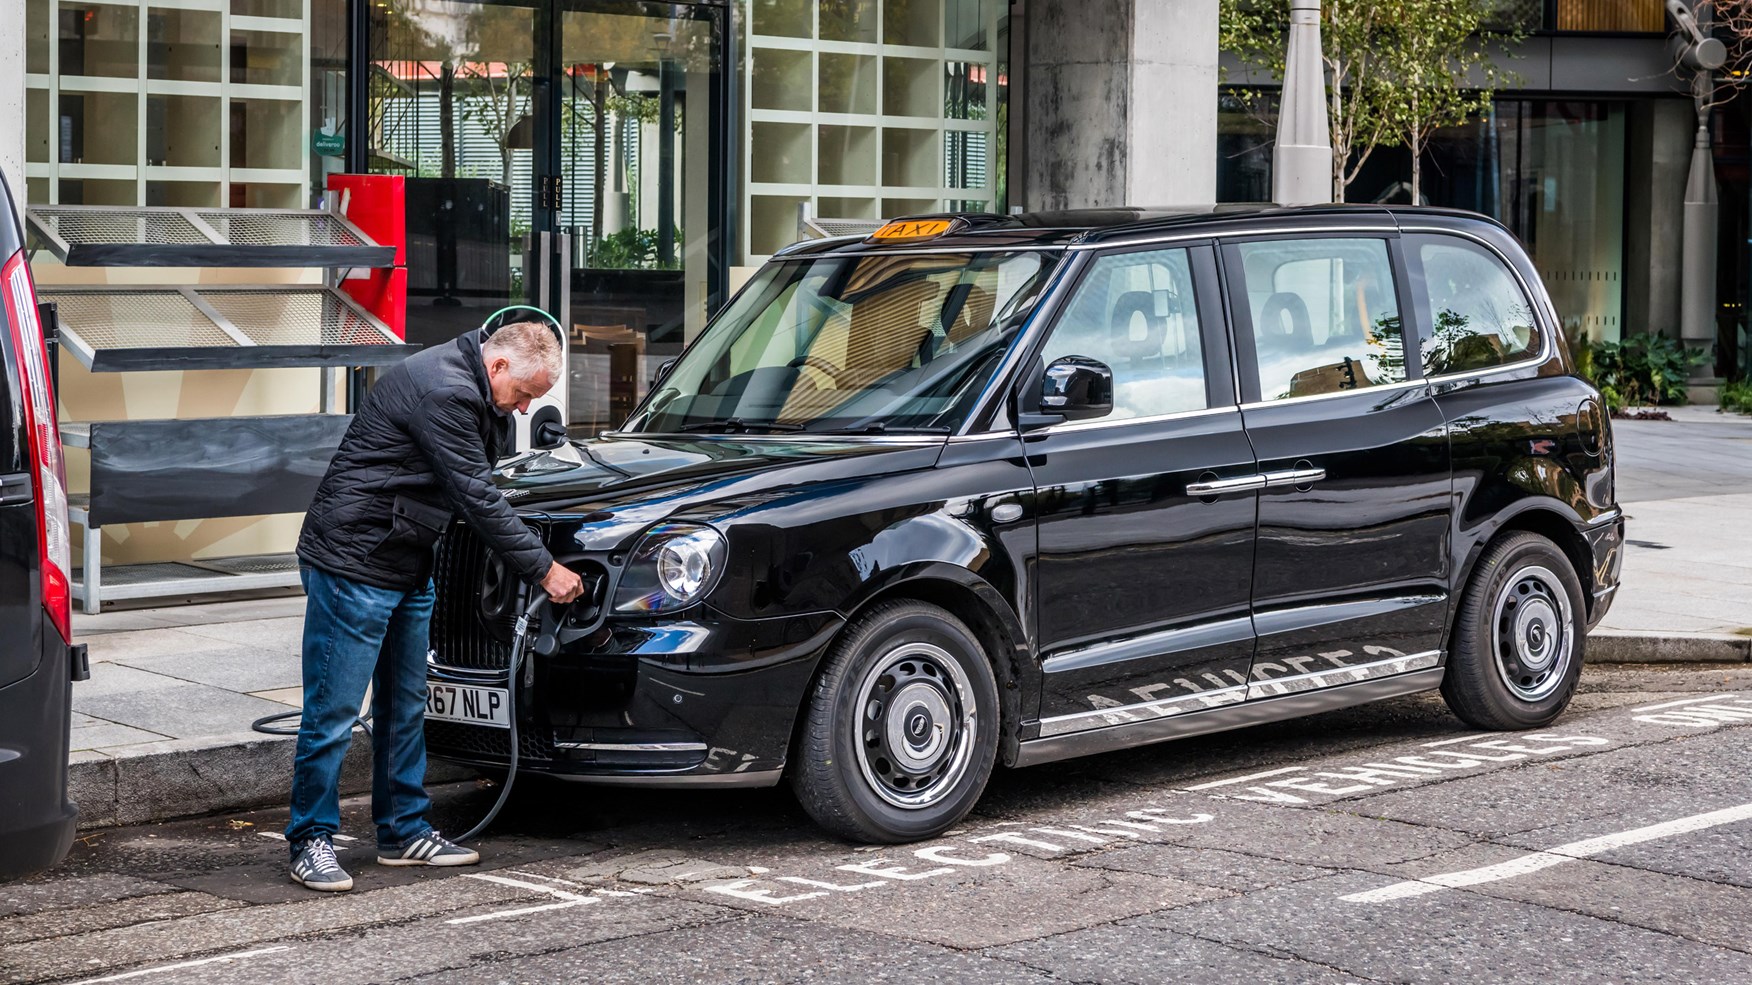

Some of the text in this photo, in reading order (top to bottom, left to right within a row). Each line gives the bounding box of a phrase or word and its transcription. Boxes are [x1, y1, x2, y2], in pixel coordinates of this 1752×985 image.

[880, 223, 939, 237] TAXI
[462, 689, 500, 720] NLP
[1209, 733, 1609, 803] VEHICLES
